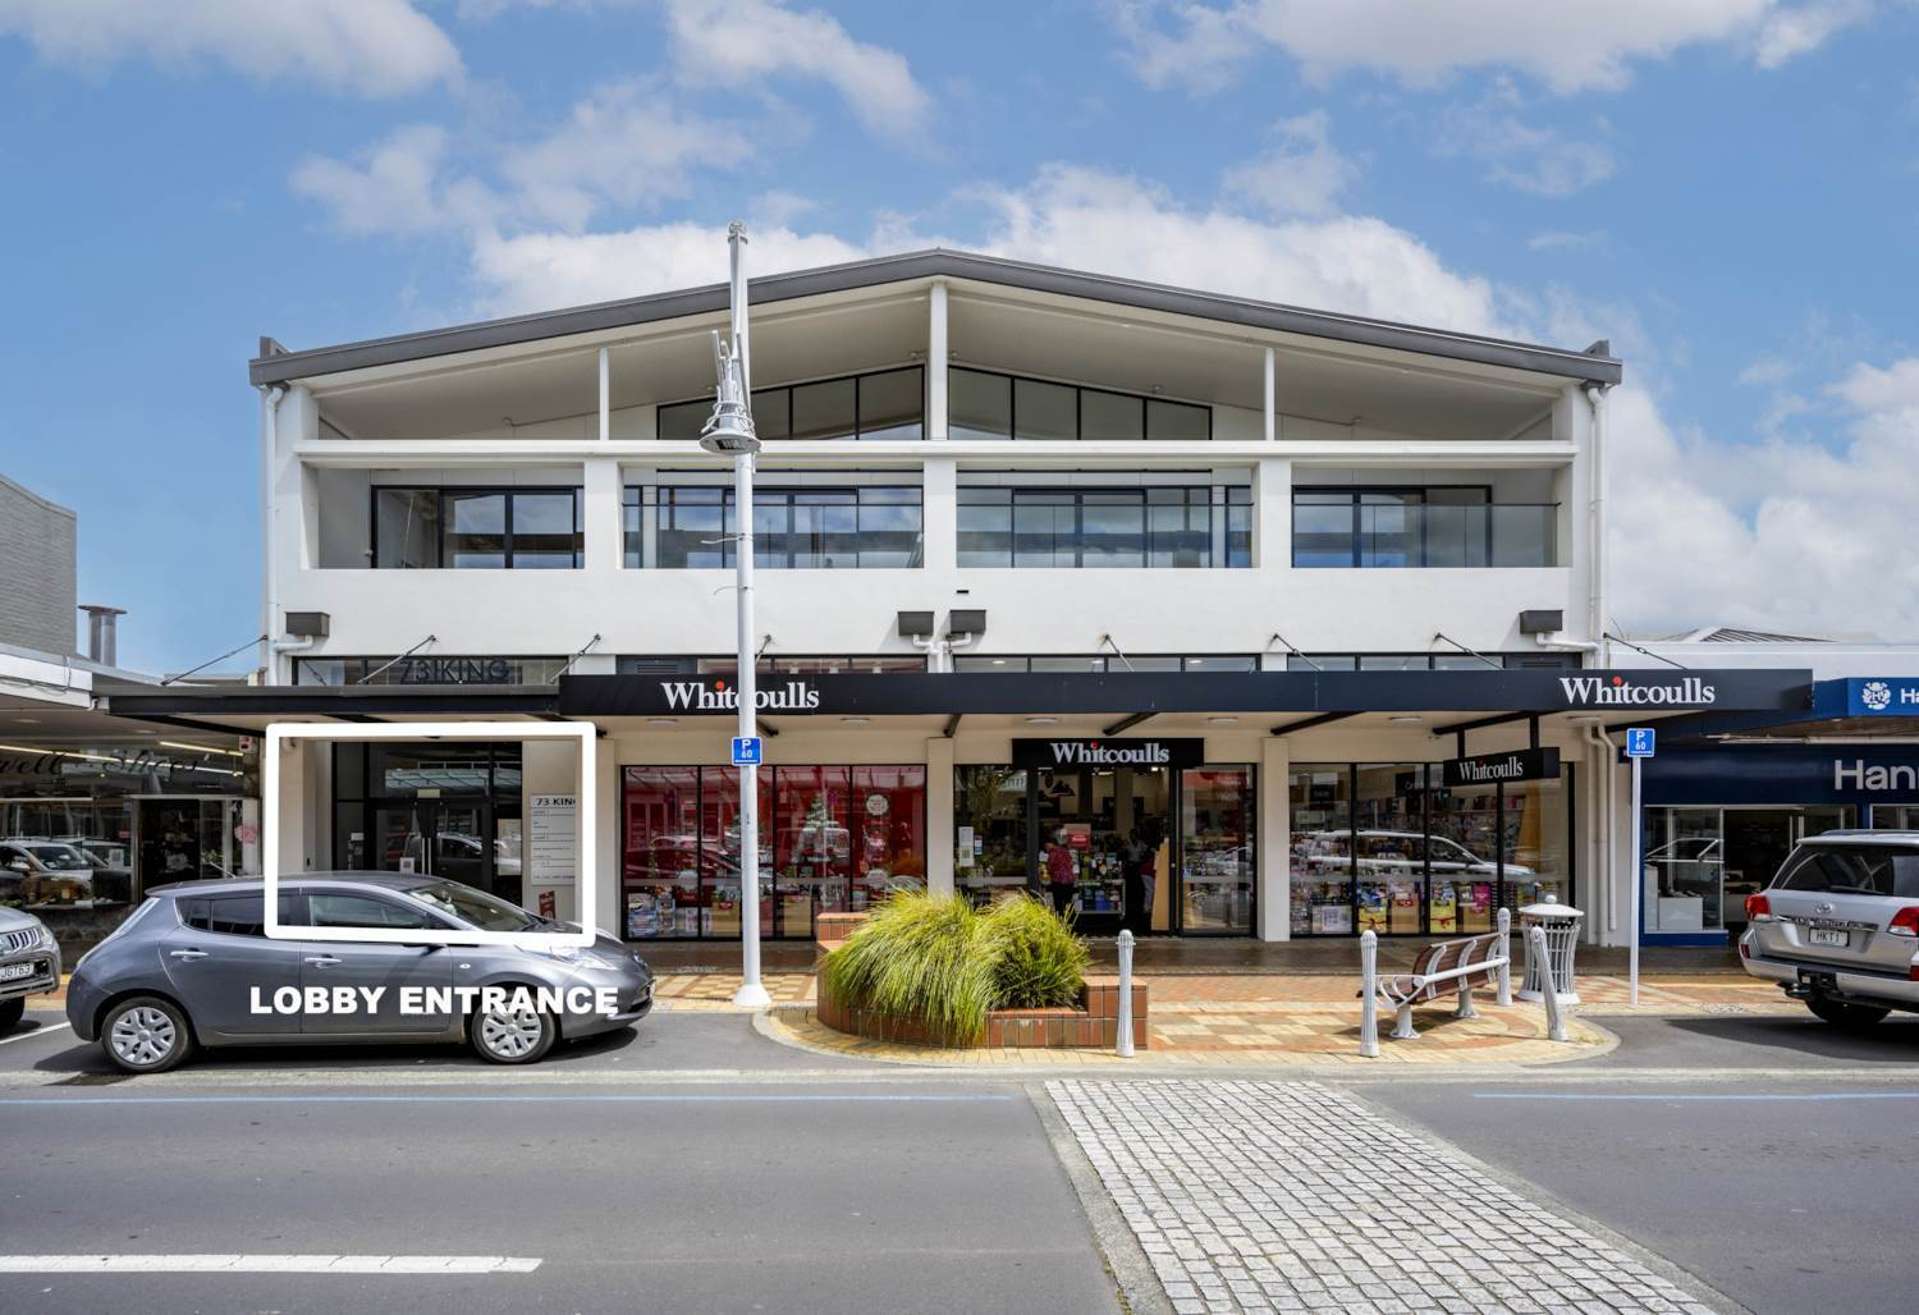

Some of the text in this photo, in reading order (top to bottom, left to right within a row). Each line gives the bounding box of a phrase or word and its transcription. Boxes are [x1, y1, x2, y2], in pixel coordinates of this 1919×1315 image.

[1560, 675, 1715, 704] Whitcoulls
[1636, 731, 1645, 741] P
[741, 739, 751, 749] P
[1635, 742, 1646, 750] 60
[741, 750, 753, 758] 60
[1051, 740, 1170, 763] Whitcoulls
[1460, 756, 1523, 780] Whitcoulls
[1834, 759, 1919, 790] Han
[536, 797, 576, 806] 73 KIN
